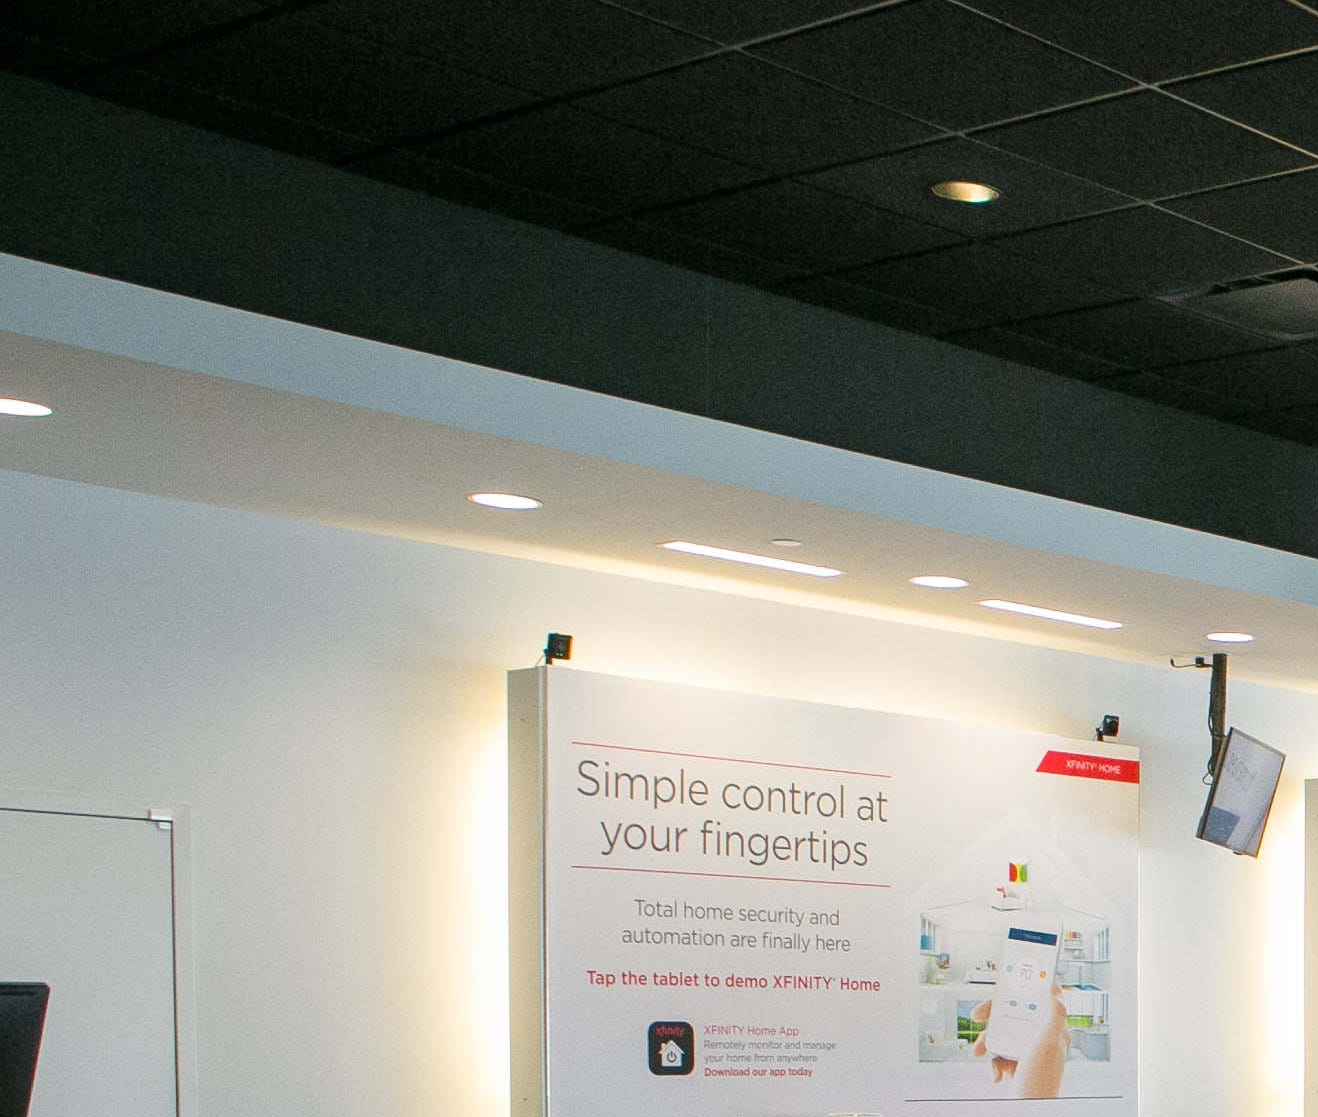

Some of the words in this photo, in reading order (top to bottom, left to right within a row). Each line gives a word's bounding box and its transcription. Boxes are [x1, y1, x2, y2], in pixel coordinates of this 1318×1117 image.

[1098, 763, 1121, 775] HOME
[577, 759, 709, 809] Simple
[722, 782, 844, 818] control
[857, 791, 888, 822] at
[600, 821, 688, 856] your
[700, 820, 868, 872] fingertips
[634, 899, 677, 918] Total
[683, 901, 734, 921] home
[738, 906, 804, 927] security
[809, 909, 840, 926] and
[622, 929, 725, 947] automation
[730, 934, 757, 948] are
[762, 932, 811, 953] finally
[815, 935, 851, 952] here
[587, 970, 616, 988] Tap
[621, 970, 647, 986] the
[653, 971, 700, 988] tablet
[704, 973, 720, 988] to
[725, 973, 768, 989] demo
[840, 977, 881, 991] Home
[655, 1025, 685, 1037] xfinity
[704, 1026, 744, 1036] XFINITY
[748, 1026, 777, 1036] Home
[779, 1026, 799, 1038] App
[704, 1040, 745, 1051] Remotely
[750, 1041, 782, 1050] monitor
[785, 1041, 801, 1050] and
[802, 1042, 836, 1052] manage
[704, 1054, 723, 1064] your
[726, 1053, 750, 1063] home
[754, 1053, 775, 1063] from
[704, 1067, 750, 1077] Download
[752, 1068, 766, 1077] our
[769, 1068, 786, 1079] app
[788, 1067, 813, 1079] today
